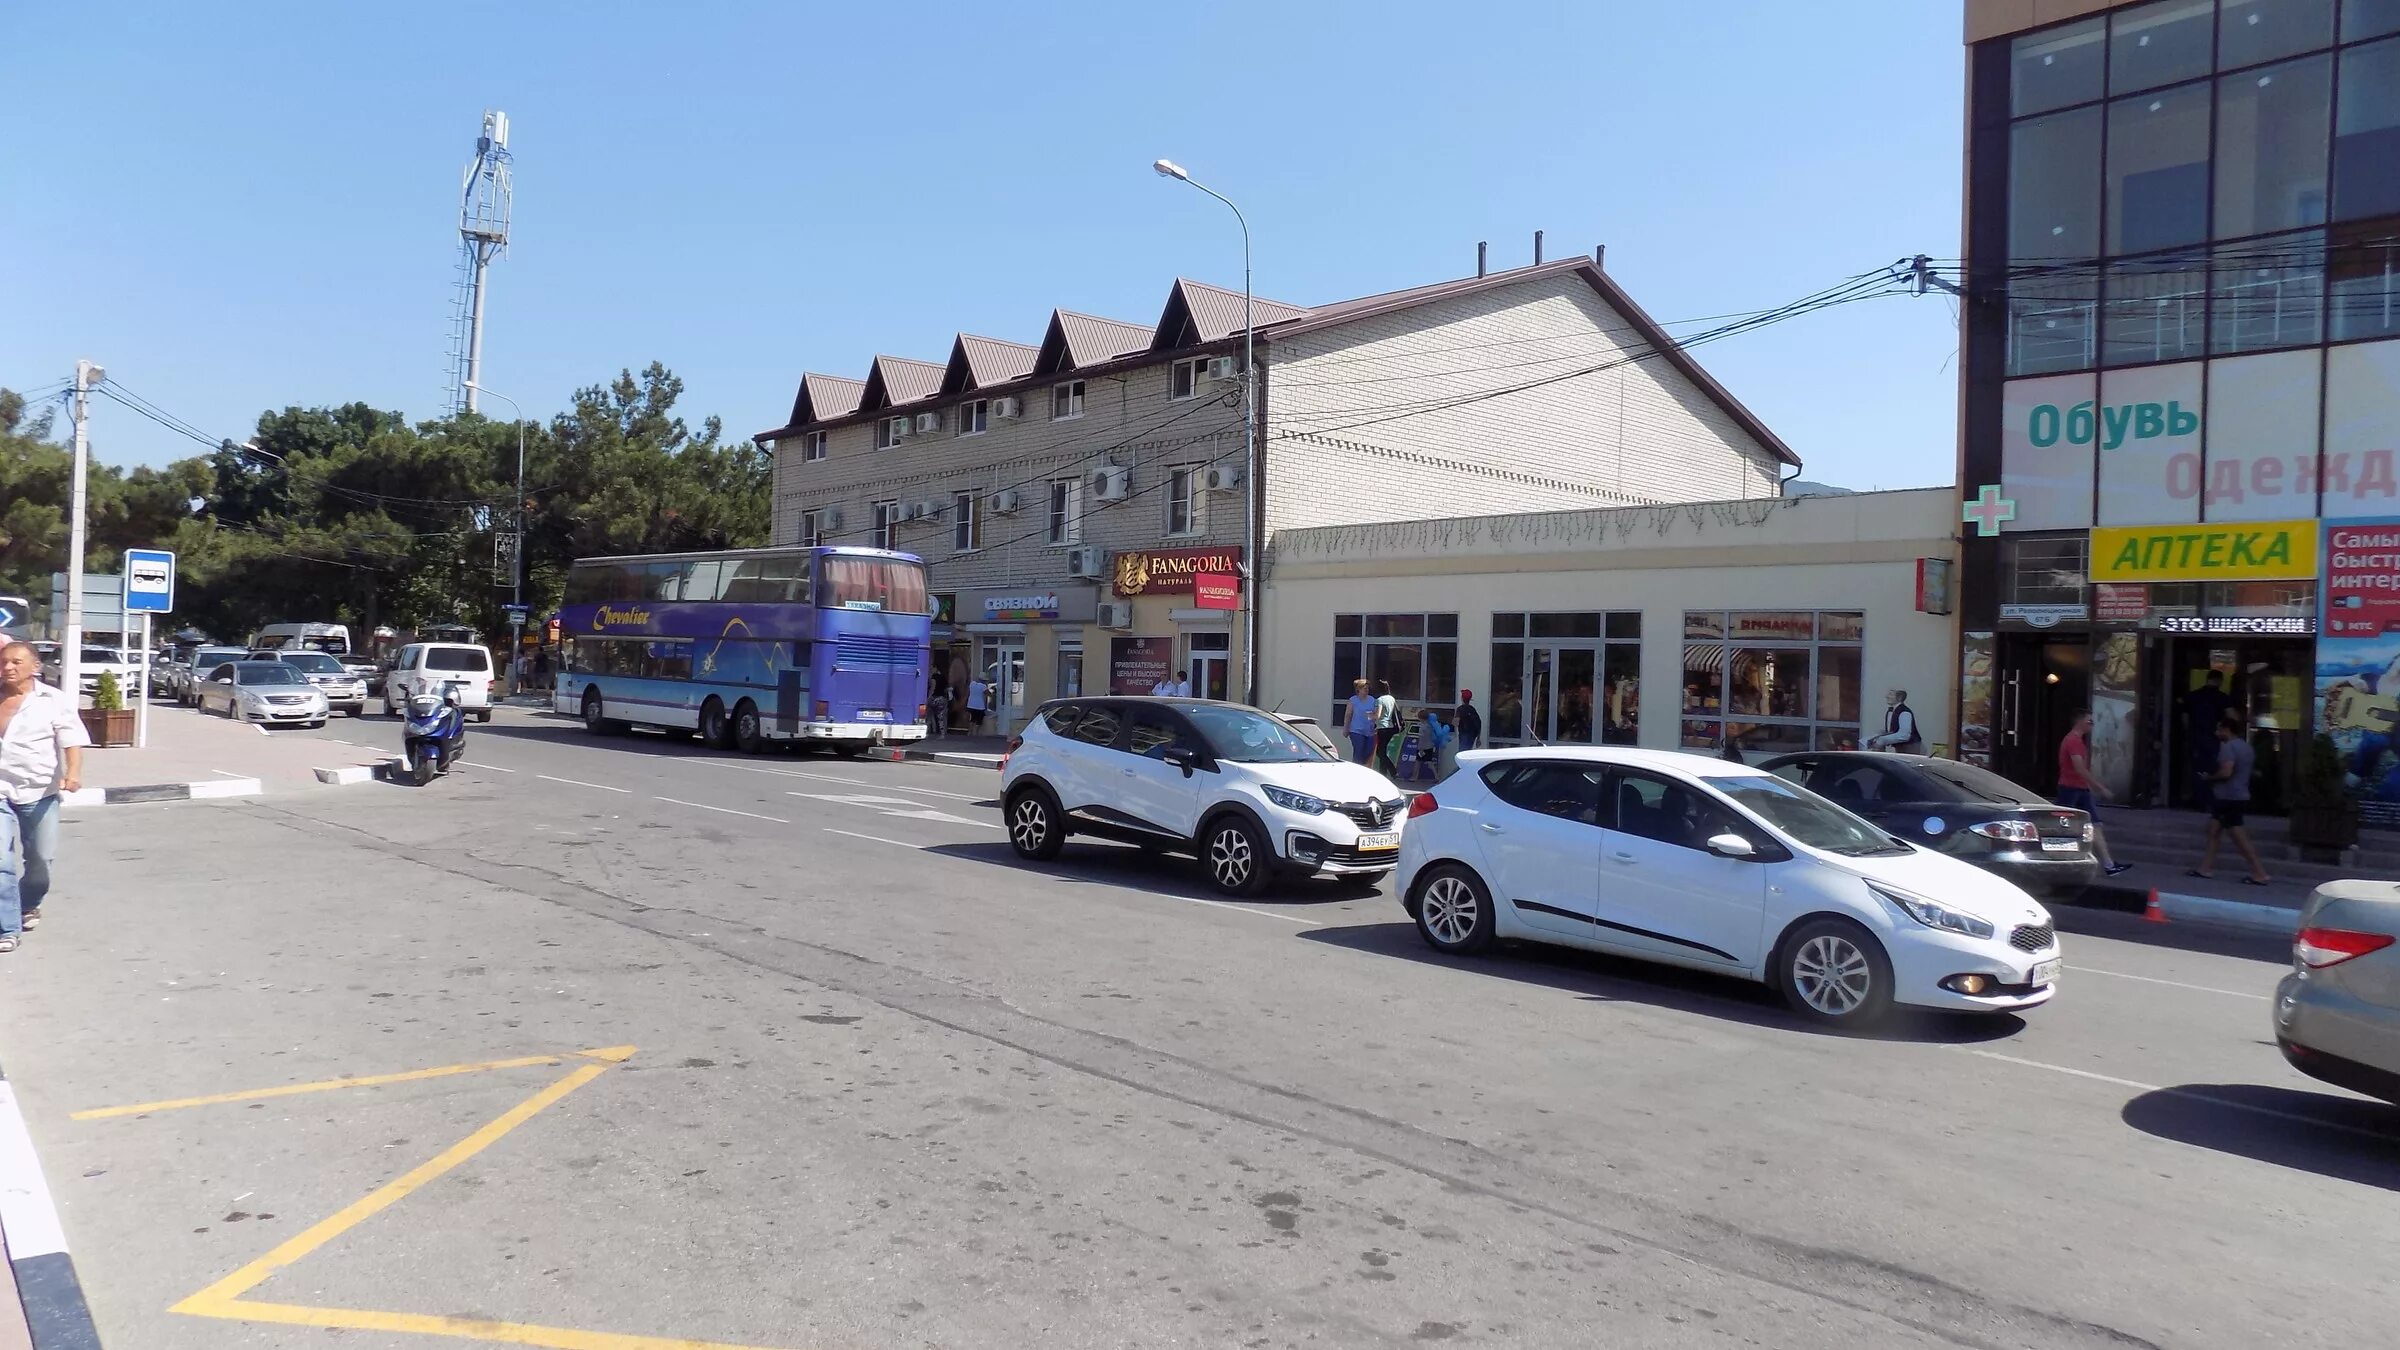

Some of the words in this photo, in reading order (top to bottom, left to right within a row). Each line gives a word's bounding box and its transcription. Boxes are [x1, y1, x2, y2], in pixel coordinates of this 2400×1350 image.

[2028, 400, 2199, 450] Обувь
[2165, 449, 2398, 505] Одежд
[2111, 531, 2290, 571] АПТЕКА
[1151, 554, 1233, 575] FANAGORIA
[1199, 586, 1235, 596] FANAGORIA
[2331, 574, 2400, 591] интер
[984, 593, 1058, 610] СВЯЗНОЙ
[592, 604, 650, 631] Chevalier
[1138, 670, 1160, 678] ВЫСОКО
